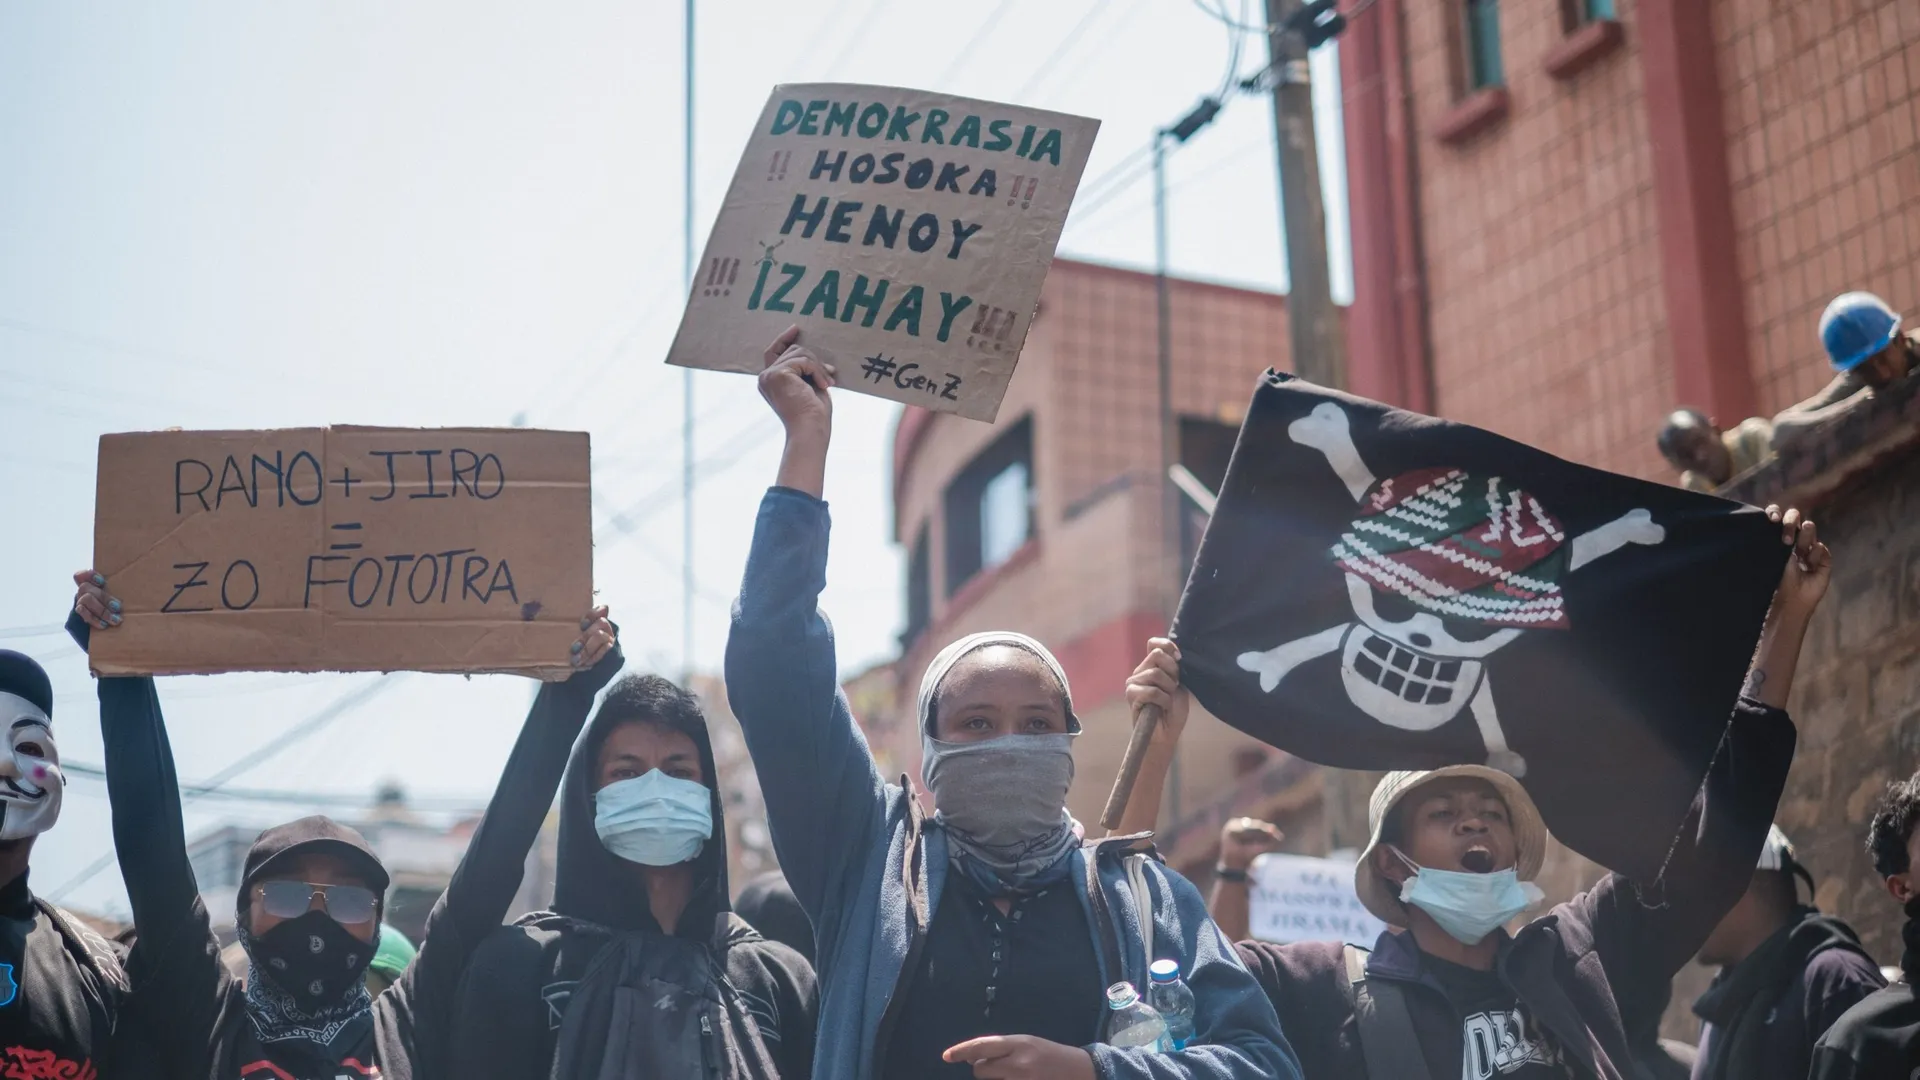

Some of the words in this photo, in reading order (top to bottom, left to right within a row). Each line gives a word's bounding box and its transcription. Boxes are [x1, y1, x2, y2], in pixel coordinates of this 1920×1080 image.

[770, 99, 1062, 166] DEMOKRASIA
[767, 150, 792, 181] !!
[809, 150, 997, 196] HOSOKA
[1007, 175, 1039, 210] !!
[779, 194, 982, 259] HENOY
[747, 260, 974, 343] IZAHAY
[175, 450, 324, 514] RANO
[370, 449, 504, 500] JIRO
[331, 523, 363, 550] =
[160, 559, 260, 613] ZO
